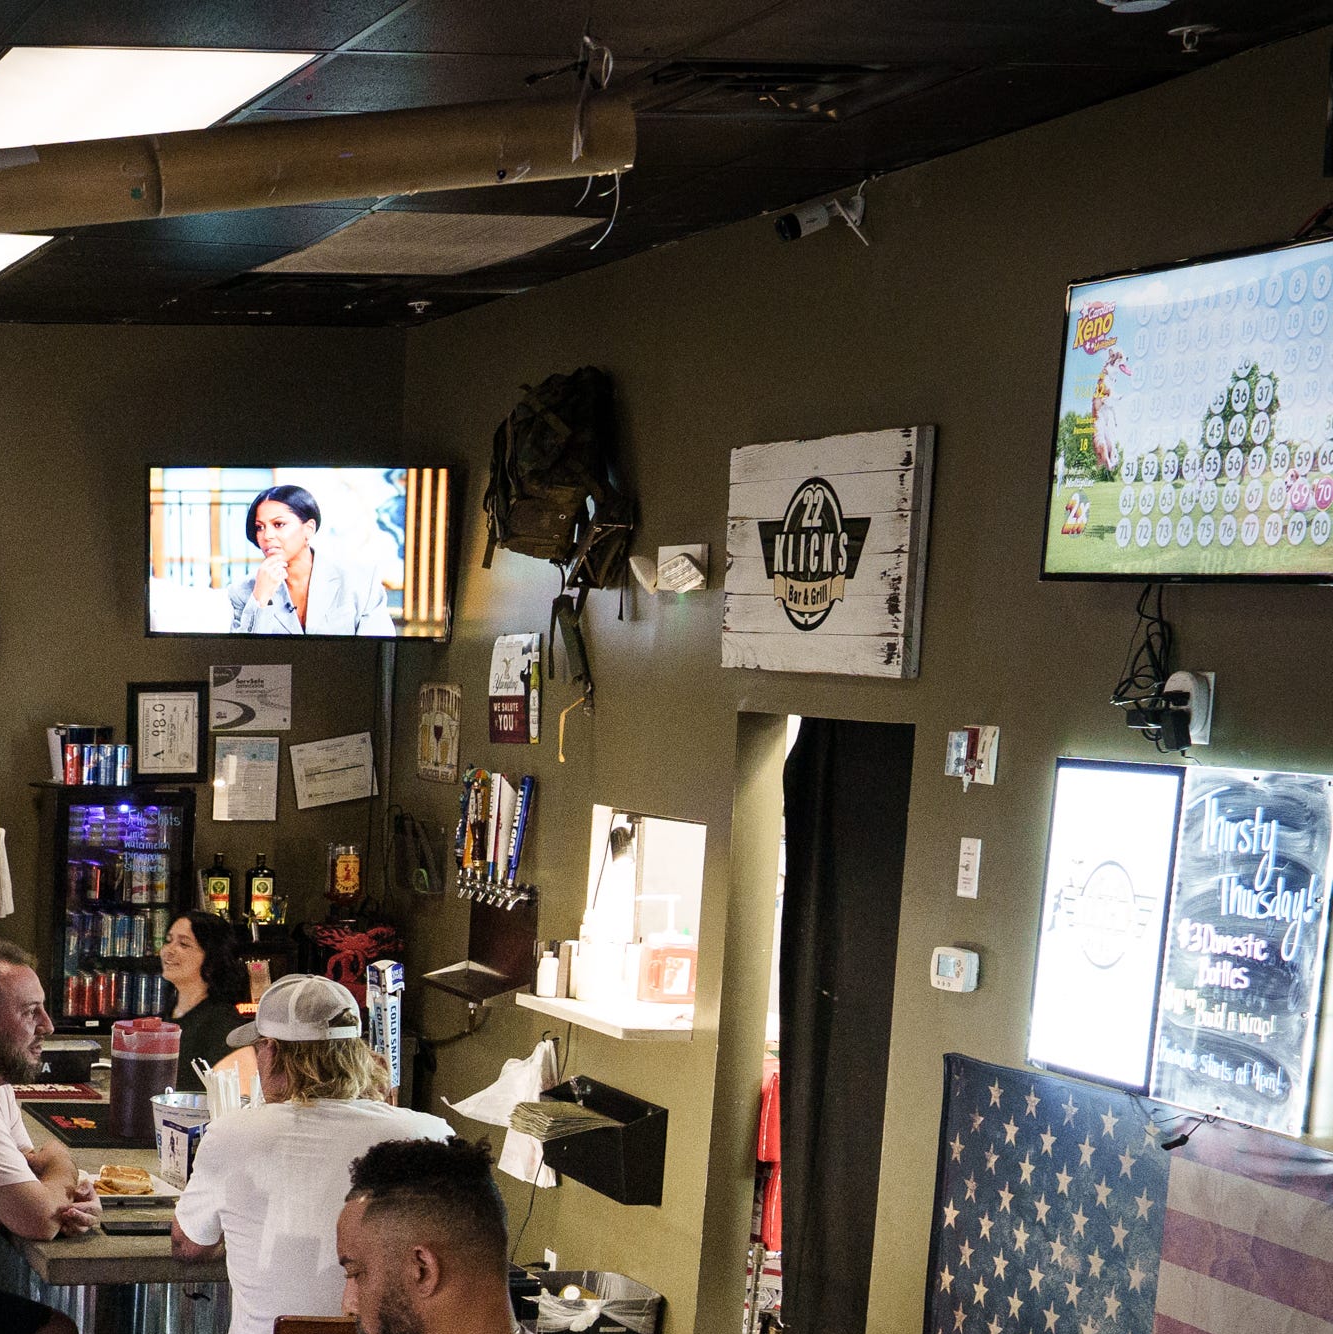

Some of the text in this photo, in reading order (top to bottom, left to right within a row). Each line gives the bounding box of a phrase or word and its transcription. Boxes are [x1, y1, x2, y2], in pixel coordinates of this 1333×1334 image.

[1072, 312, 1115, 350] Keno
[1234, 384, 1271, 404] 36 37
[1208, 418, 1267, 439] 45 46 47
[1143, 450, 1311, 476] 52 53 54 55 56 57 58 59
[800, 486, 825, 529] 22
[1140, 487, 1260, 507] 62 63 66 67
[773, 531, 849, 574] KLICKS
[788, 584, 828, 607] Bar & Grill
[493, 702, 519, 712] WE SALUTE
[498, 713, 514, 731] YOU
[148, 809, 182, 827] Shots
[514, 784, 526, 824] LIGHT
[508, 823, 520, 856] BUD
[1186, 785, 1290, 892] Thirsty
[1209, 873, 1320, 962] Thursday!
[1201, 922, 1270, 962] Domestic
[1238, 1011, 1278, 1043] Wrap!
[390, 1039, 398, 1071] SNAP
